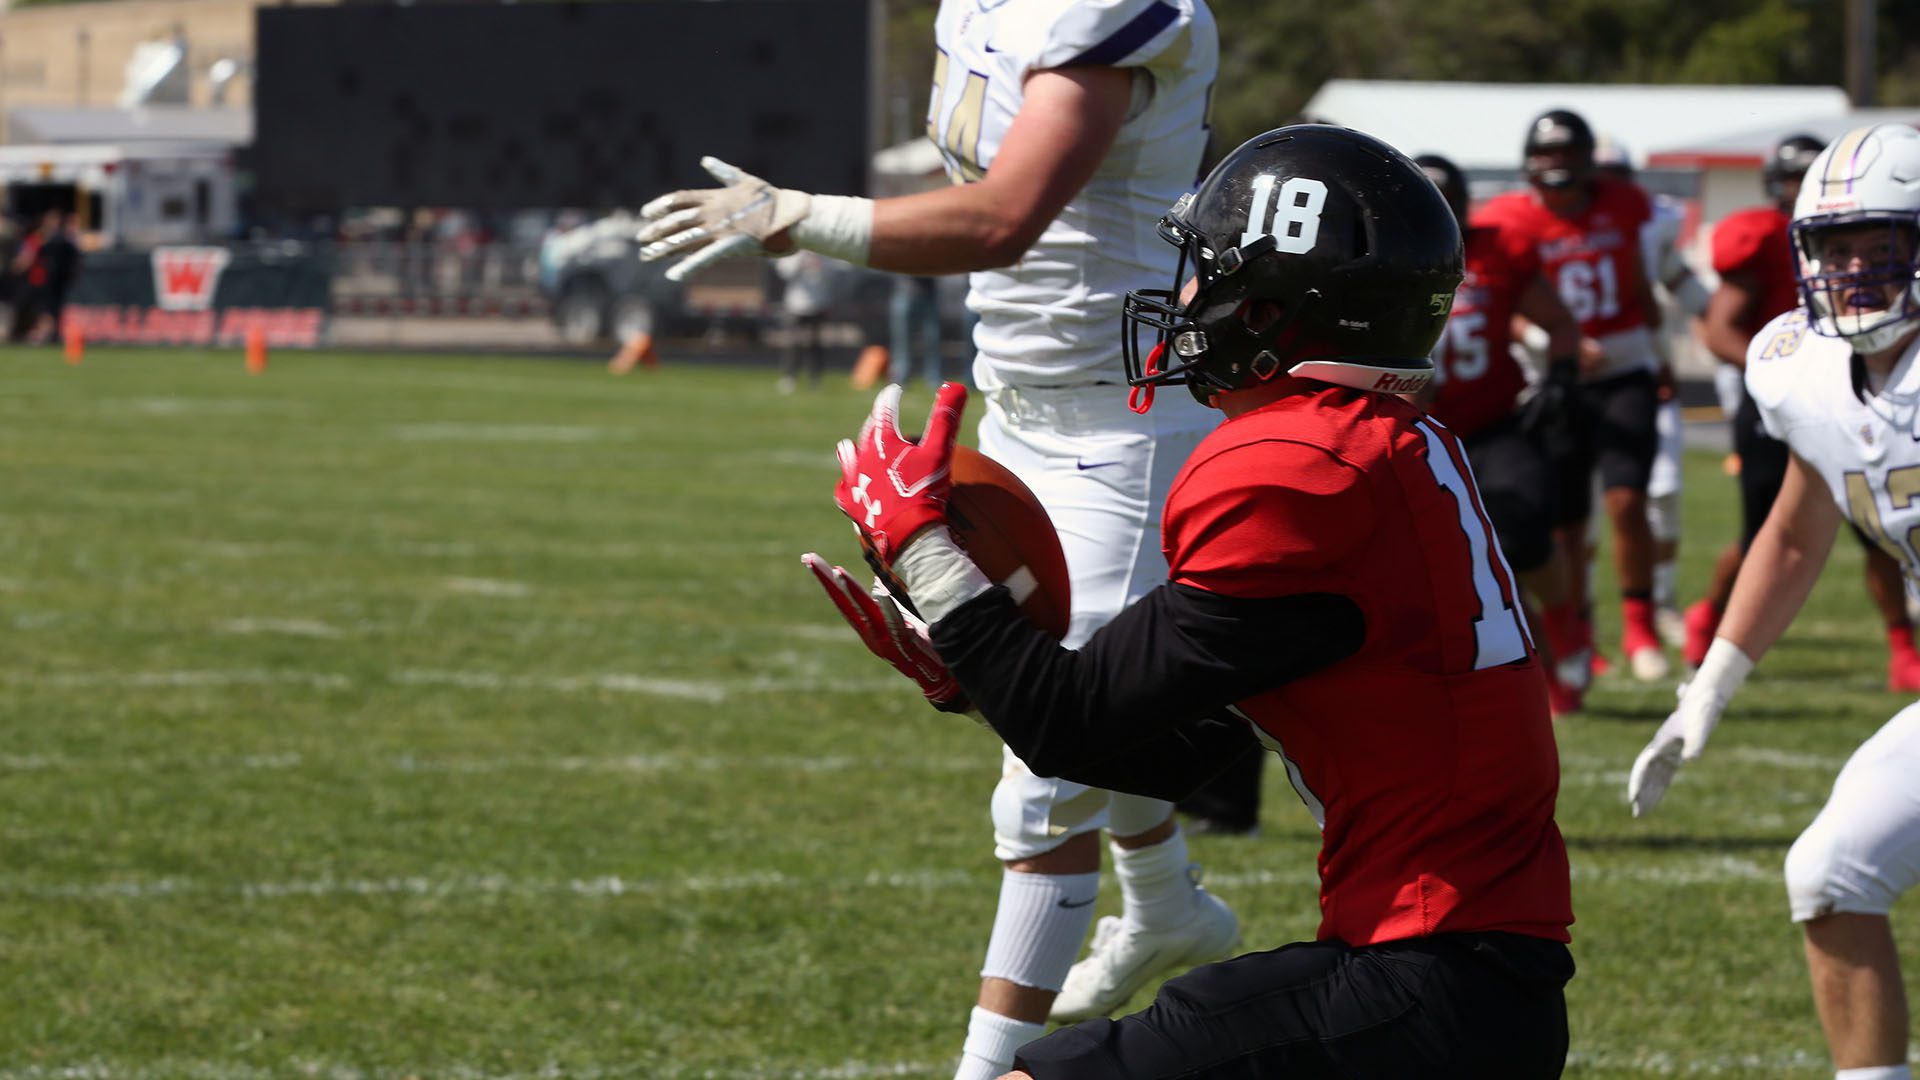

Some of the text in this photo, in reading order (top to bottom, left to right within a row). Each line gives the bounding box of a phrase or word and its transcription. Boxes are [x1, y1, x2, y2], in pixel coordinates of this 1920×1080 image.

[1240, 174, 1329, 255] 18
[162, 254, 217, 296] W
[1557, 256, 1621, 322] 61
